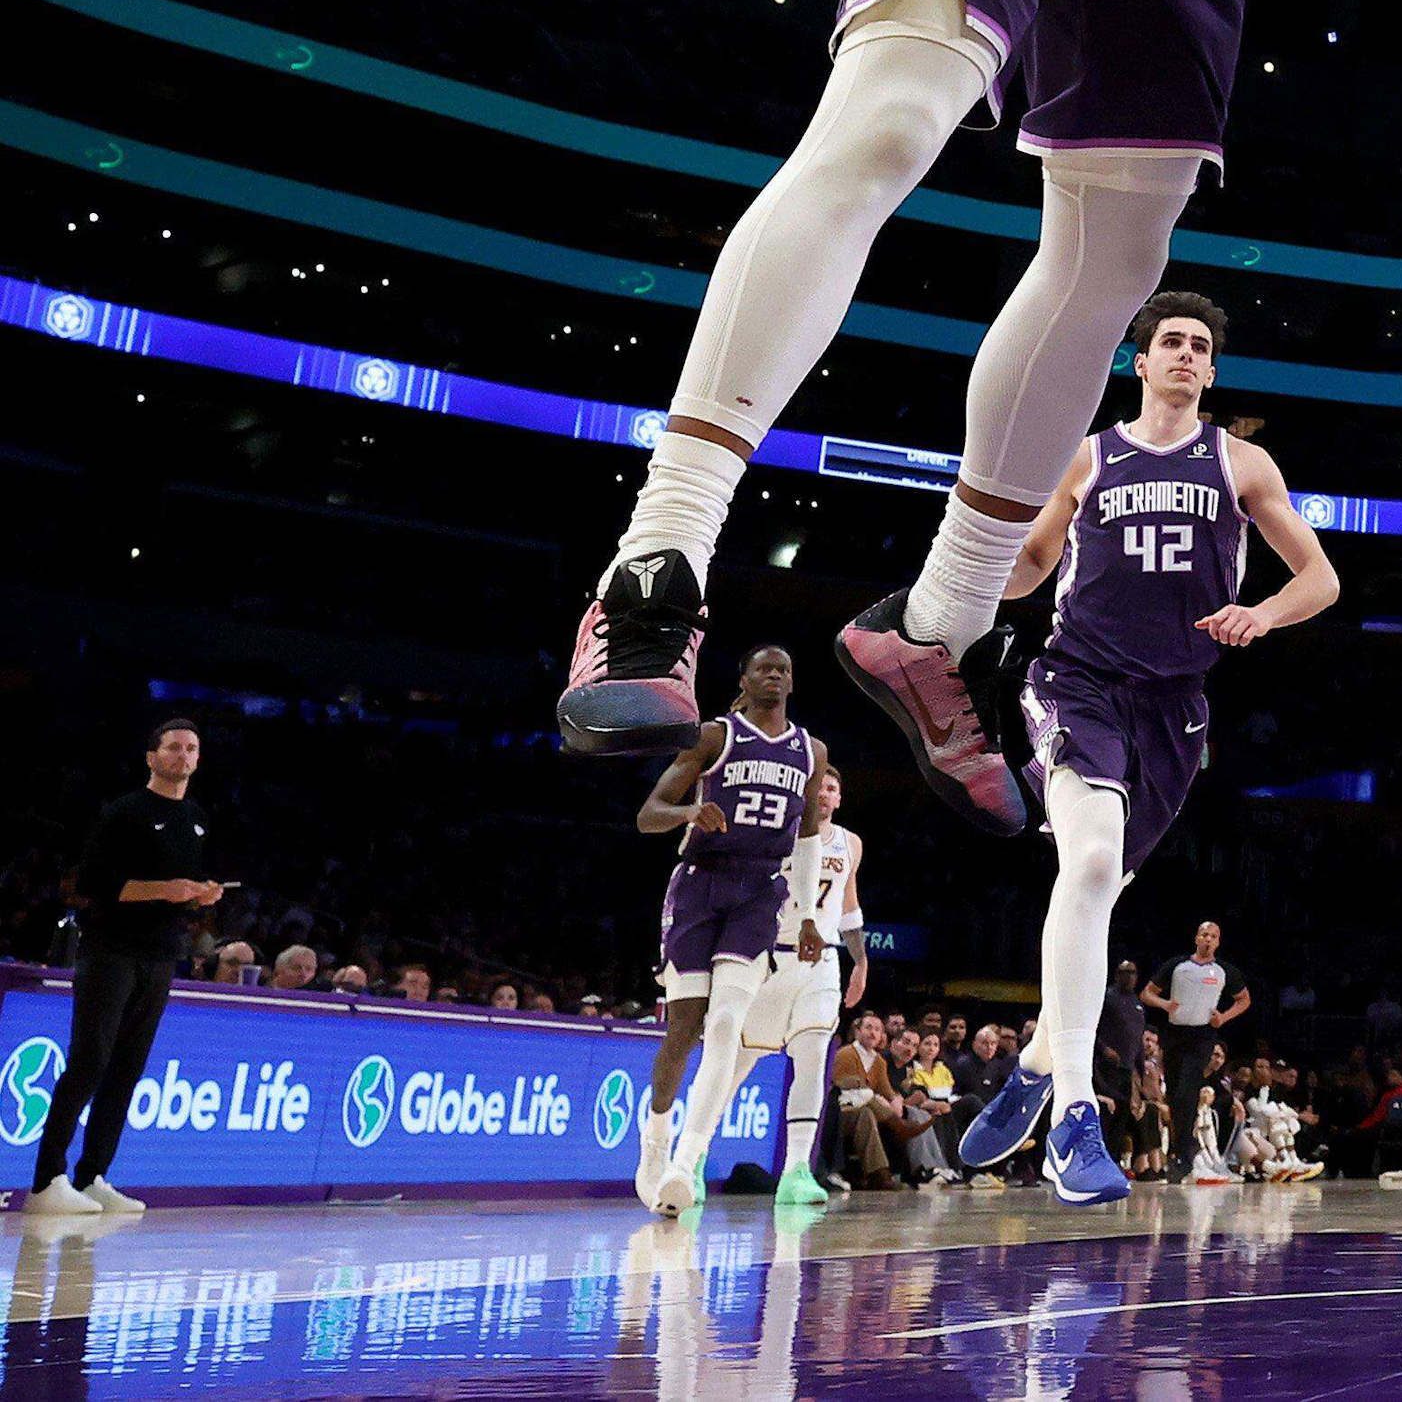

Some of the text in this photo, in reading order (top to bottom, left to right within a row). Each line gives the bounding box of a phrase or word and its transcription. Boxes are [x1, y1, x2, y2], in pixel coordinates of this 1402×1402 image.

[1098, 481, 1219, 525] SACRAMENTO
[1123, 525, 1193, 572] 42
[734, 791, 787, 828] 23
[127, 1059, 311, 1132] obe Life
[401, 1071, 503, 1135] Globe
[509, 1074, 571, 1136] Life
[721, 1084, 770, 1139] Life
